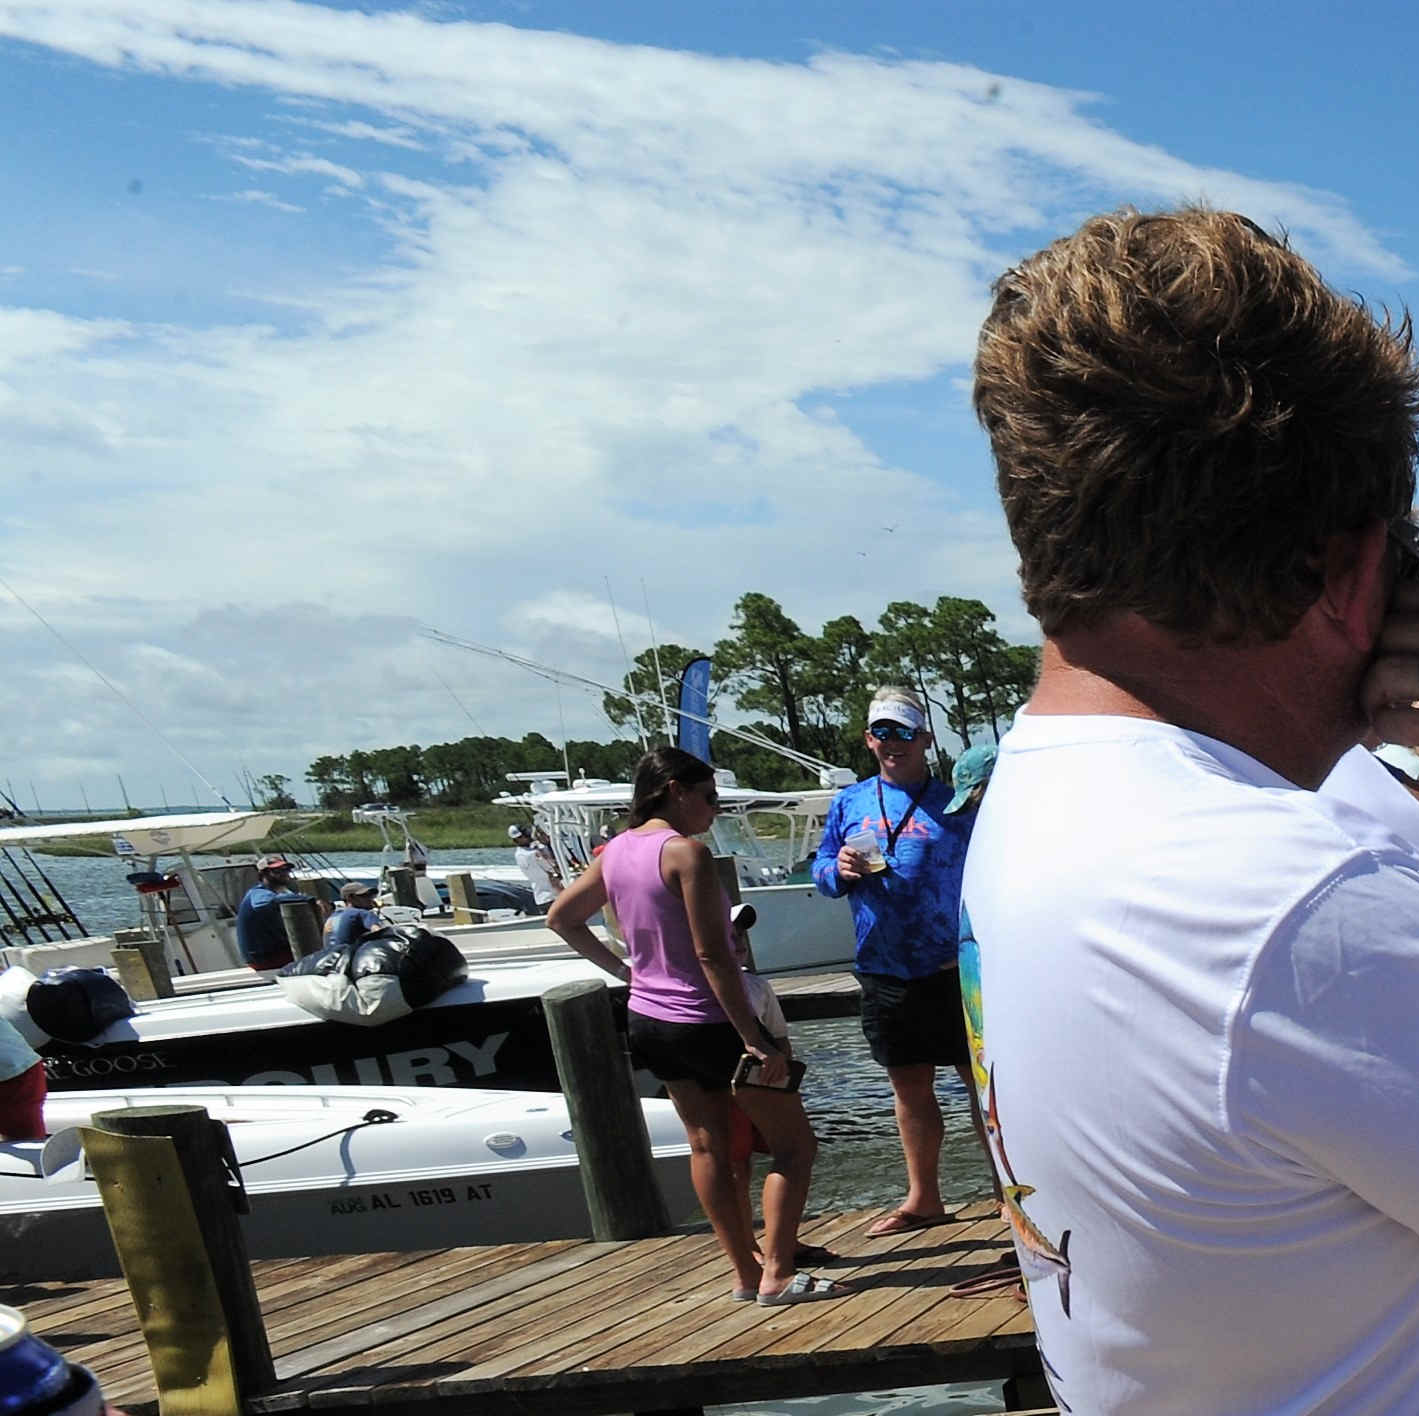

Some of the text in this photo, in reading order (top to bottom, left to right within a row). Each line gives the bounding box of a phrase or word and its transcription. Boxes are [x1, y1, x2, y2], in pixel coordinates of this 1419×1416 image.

[371, 1193, 400, 1211] AL
[408, 1187, 456, 1208] 1619
[466, 1184, 493, 1202] AT
